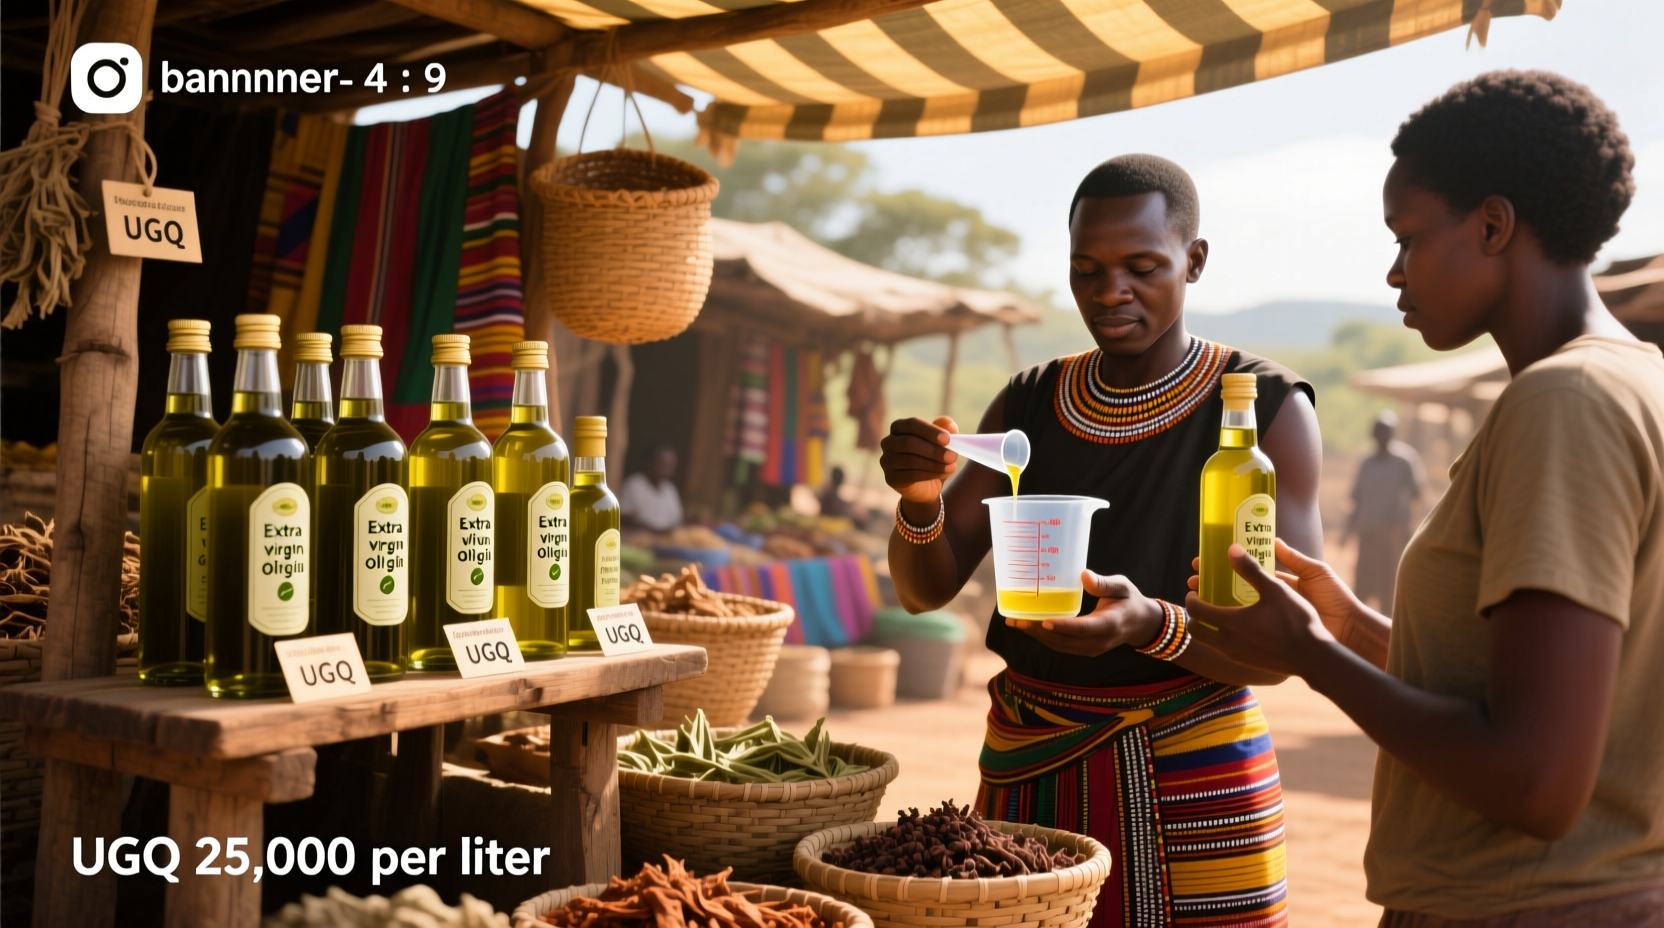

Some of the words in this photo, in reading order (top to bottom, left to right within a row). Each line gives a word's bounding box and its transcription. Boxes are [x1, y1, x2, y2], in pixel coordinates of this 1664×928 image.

[123, 214, 186, 250] UGQ
[264, 523, 302, 538] Extra
[368, 520, 403, 534] Extra
[459, 516, 491, 531] Extra
[539, 515, 567, 529] Extra
[605, 623, 645, 645] UGQ
[465, 640, 514, 665] UGQ
[299, 660, 356, 687] UGQ
